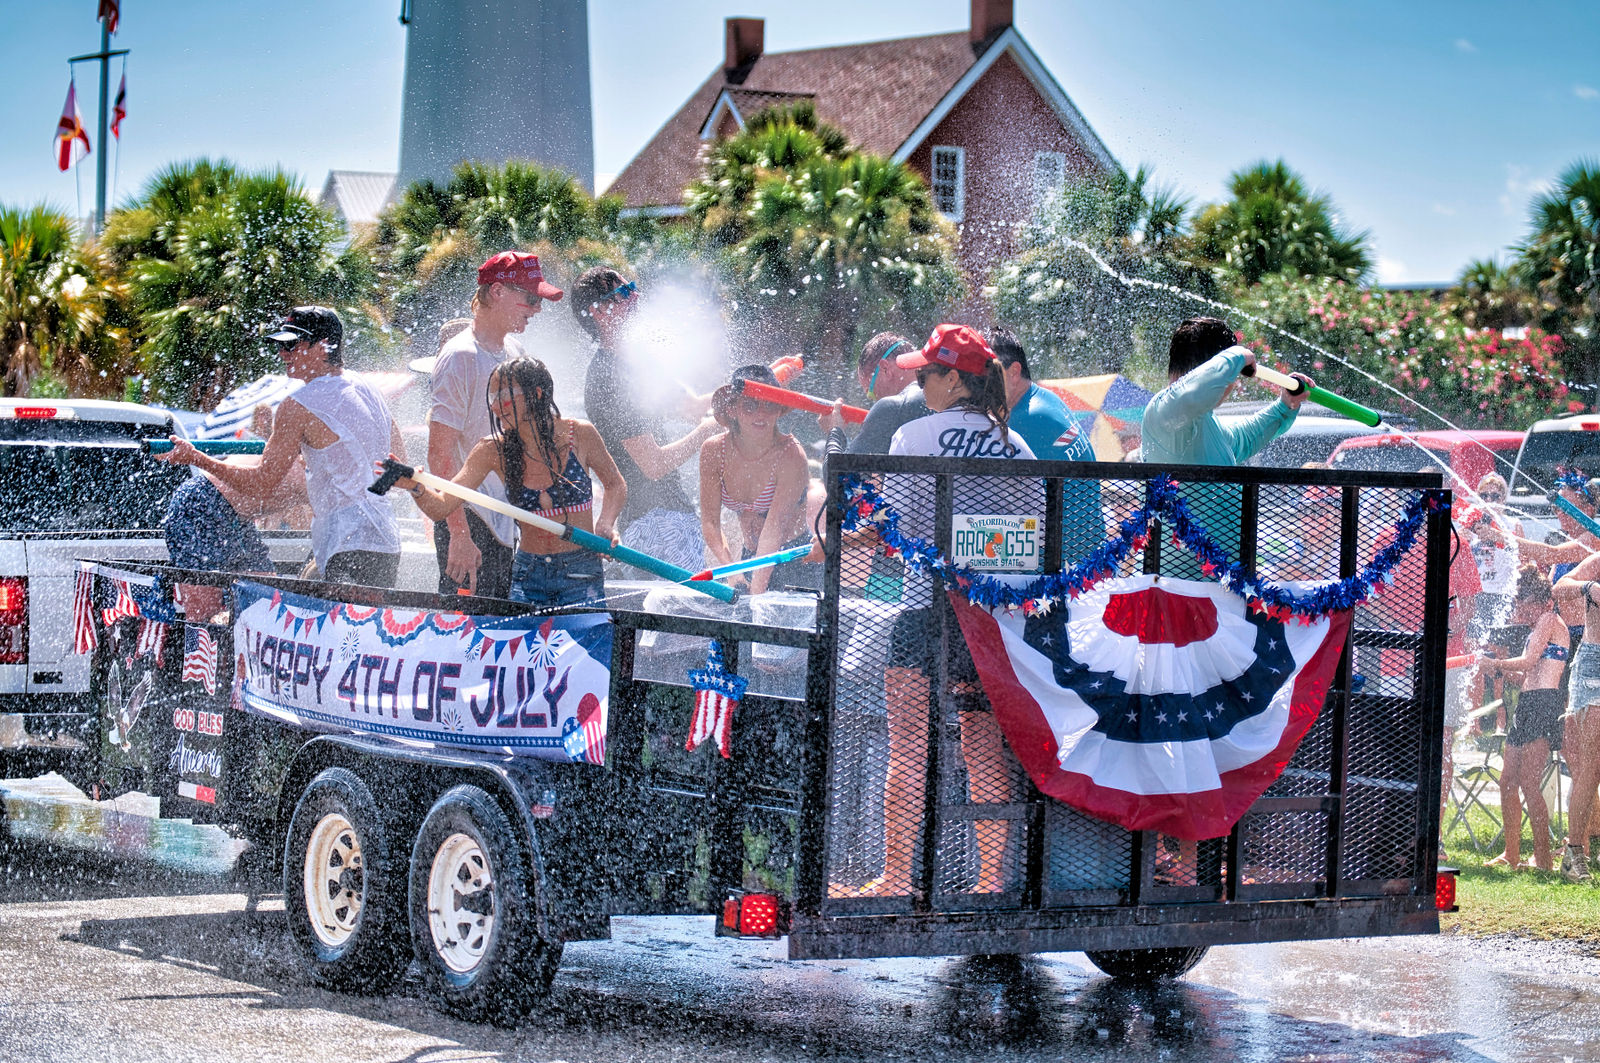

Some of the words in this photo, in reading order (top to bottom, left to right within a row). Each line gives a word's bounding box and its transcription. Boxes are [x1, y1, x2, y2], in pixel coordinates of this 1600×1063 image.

[969, 558, 999, 567] SUNSHINE
[1000, 558, 1020, 567] STATE
[245, 627, 334, 705] HAPPY
[337, 653, 406, 719] 4TH
[411, 660, 463, 723] OF
[470, 664, 573, 729] JULY
[173, 707, 195, 732] GOD
